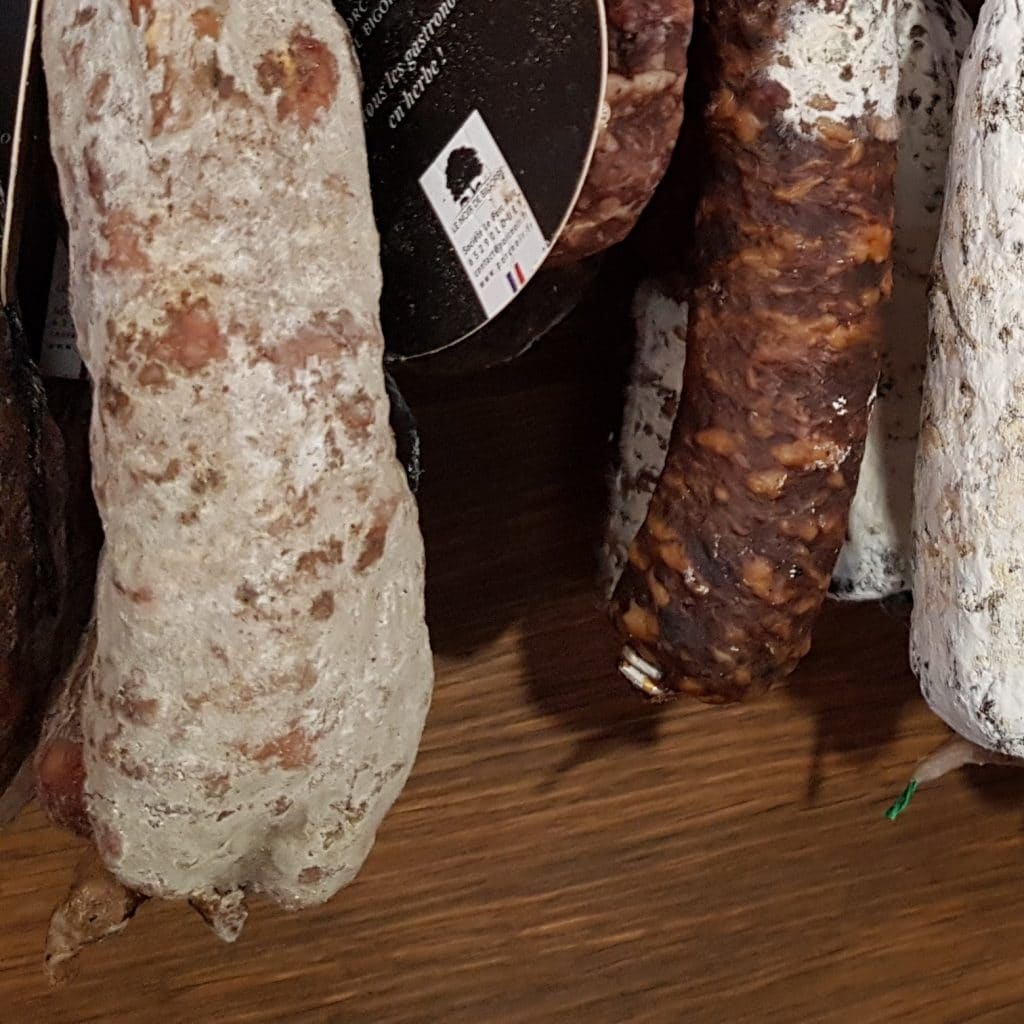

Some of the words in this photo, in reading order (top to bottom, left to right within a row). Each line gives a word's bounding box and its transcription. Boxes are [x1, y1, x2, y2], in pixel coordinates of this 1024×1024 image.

[383, 62, 407, 90] les
[387, 104, 404, 129] en
[402, 59, 441, 108] herbe
